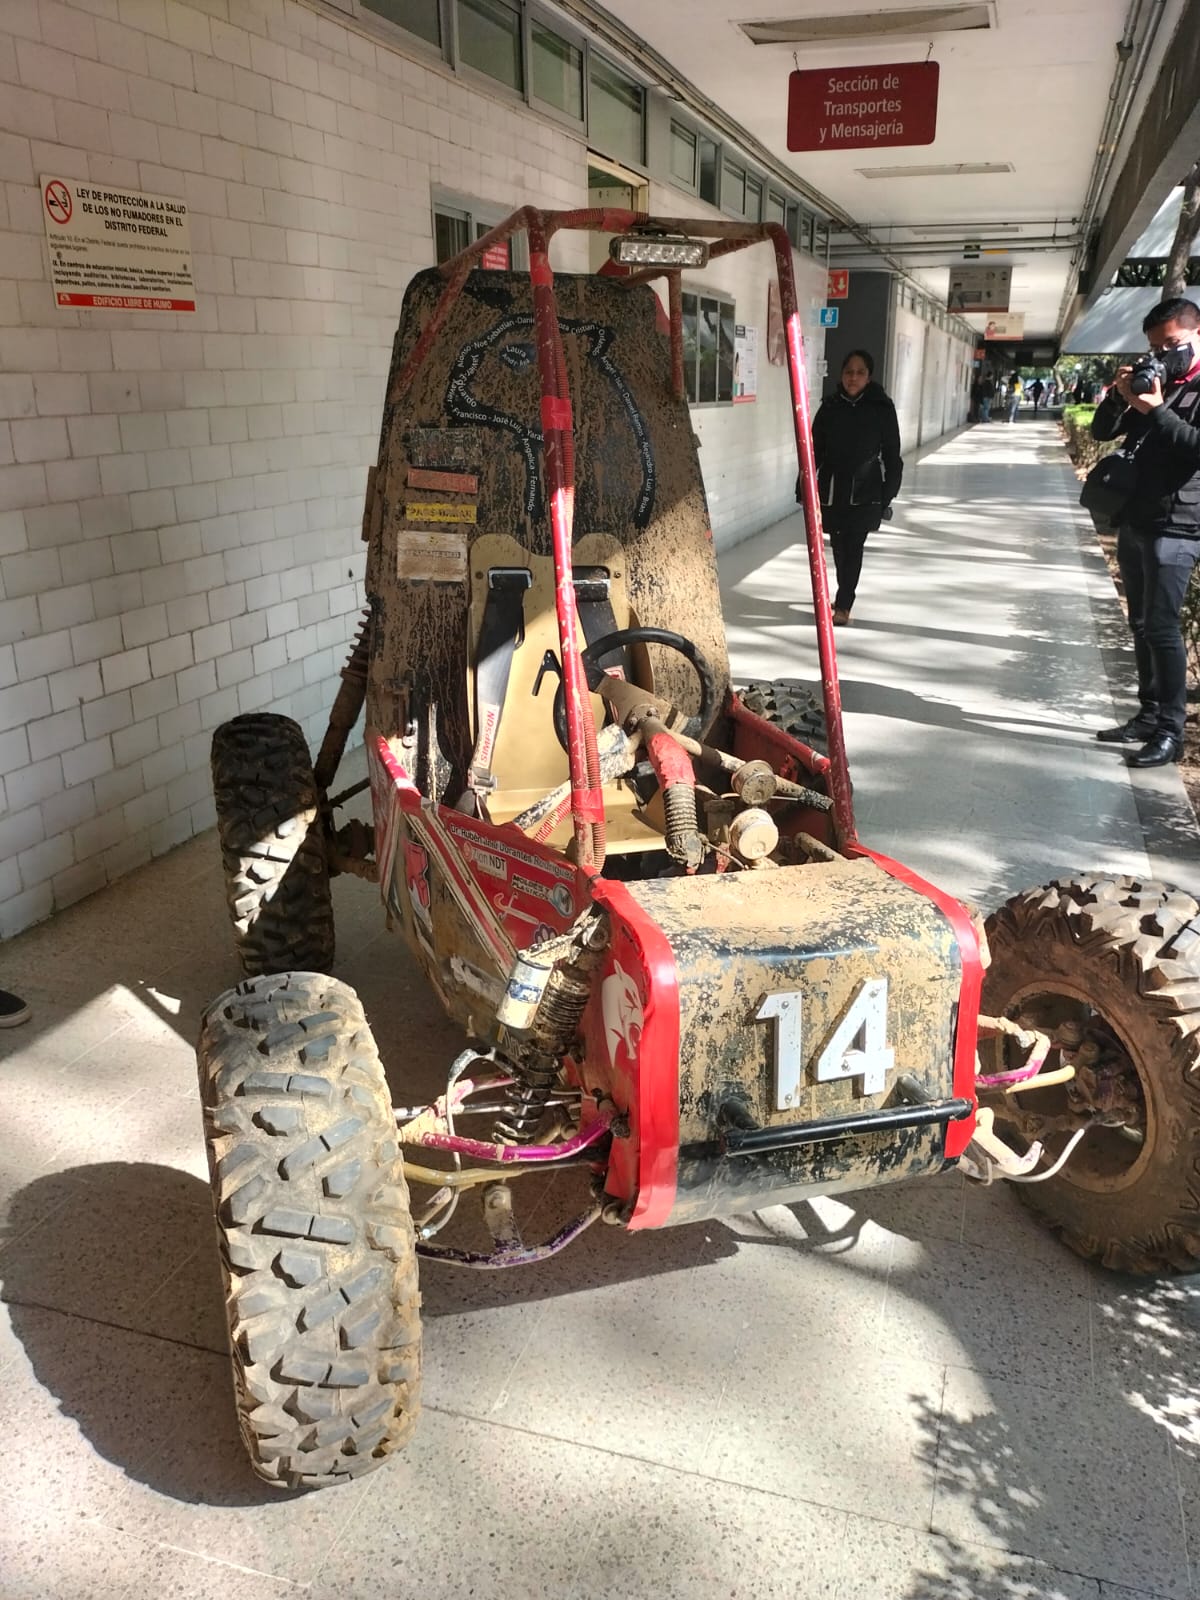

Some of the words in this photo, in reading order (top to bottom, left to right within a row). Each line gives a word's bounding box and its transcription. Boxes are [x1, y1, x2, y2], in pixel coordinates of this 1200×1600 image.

[827, 75, 879, 94] Sección
[882, 73, 900, 90] de
[823, 98, 902, 118] Transportes
[819, 127, 828, 144] y
[831, 118, 904, 140] Mensajería
[76, 188, 90, 199] LEY
[92, 190, 102, 201] DE
[103, 192, 149, 209] PROTECCIÓN
[150, 200, 155, 209] A
[156, 201, 164, 211] LA
[165, 203, 186, 215] SALUD
[82, 203, 93, 214] DE
[94, 205, 109, 216] LOS
[110, 208, 122, 218] NO
[123, 209, 164, 224] FUMADORES
[165, 216, 175, 226] EN
[175, 217, 184, 227] EL
[104, 220, 137, 233] DISTRITO
[138, 224, 169, 238] FEDERAL
[92, 296, 122, 307] EDIFICIO
[123, 296, 143, 308] LIBRE
[143, 298, 153, 309] DE
[153, 298, 173, 310] HUMO
[516, 316, 535, 325] Dani
[505, 344, 527, 358] Laura
[452, 407, 488, 421] Francisco
[527, 475, 538, 512] Fernando
[480, 710, 496, 764] SIMPSON
[489, 856, 506, 872] NDT
[752, 975, 896, 1111] 14
